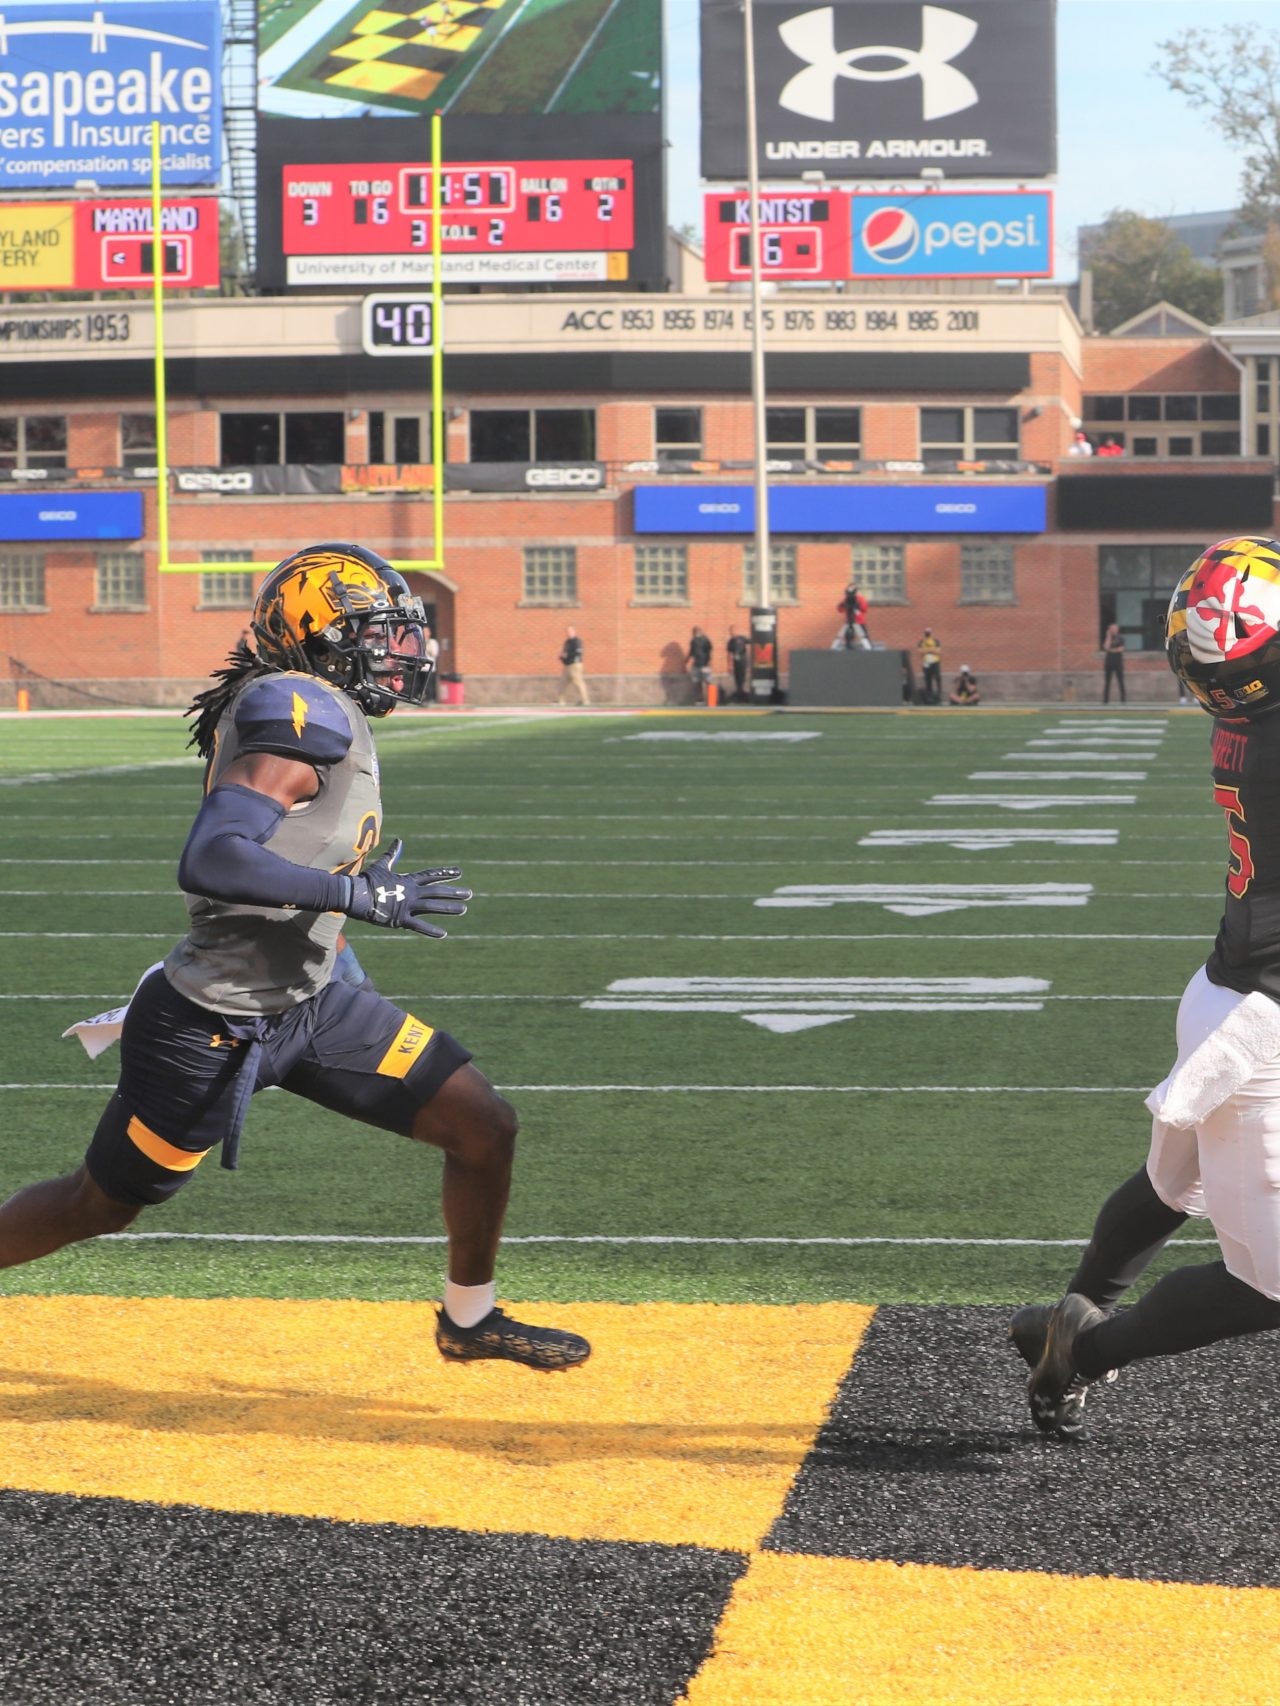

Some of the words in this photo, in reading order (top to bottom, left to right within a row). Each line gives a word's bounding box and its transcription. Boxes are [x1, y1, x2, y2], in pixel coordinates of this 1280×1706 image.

[0, 51, 212, 148] sapeake
[0, 127, 45, 149] ers
[72, 120, 211, 147] Insurance
[766, 140, 860, 160] UNDER
[866, 139, 987, 158] ARMOUR
[6, 155, 128, 176] compensation
[132, 153, 211, 174] spcialist
[287, 181, 333, 198] DOWN
[94, 207, 198, 233] MARYLAND
[303, 198, 319, 226] 3
[372, 198, 389, 225] 6
[545, 195, 562, 222] 6
[597, 194, 614, 222] 2
[735, 199, 815, 224] KNTST
[411, 220, 427, 247] 3
[488, 219, 505, 246] 2
[924, 215, 1037, 256] pepsi
[0, 249, 39, 268] ERY
[165, 240, 183, 272] 7
[763, 233, 783, 266] 6
[296, 260, 377, 276] University
[380, 261, 396, 274] of
[402, 258, 474, 275] Marland
[479, 258, 540, 272] Medical
[544, 257, 597, 271] Center
[87, 313, 130, 342] 1953
[376, 304, 431, 346] 40
[561, 310, 615, 331] ACC
[621, 310, 655, 331] 1953
[704, 310, 734, 331] 1974
[743, 310, 775, 331] 195
[525, 468, 601, 486] GEICO
[1210, 689, 1236, 710] 5
[1213, 783, 1255, 900] 5
[398, 1023, 425, 1054] KENT
